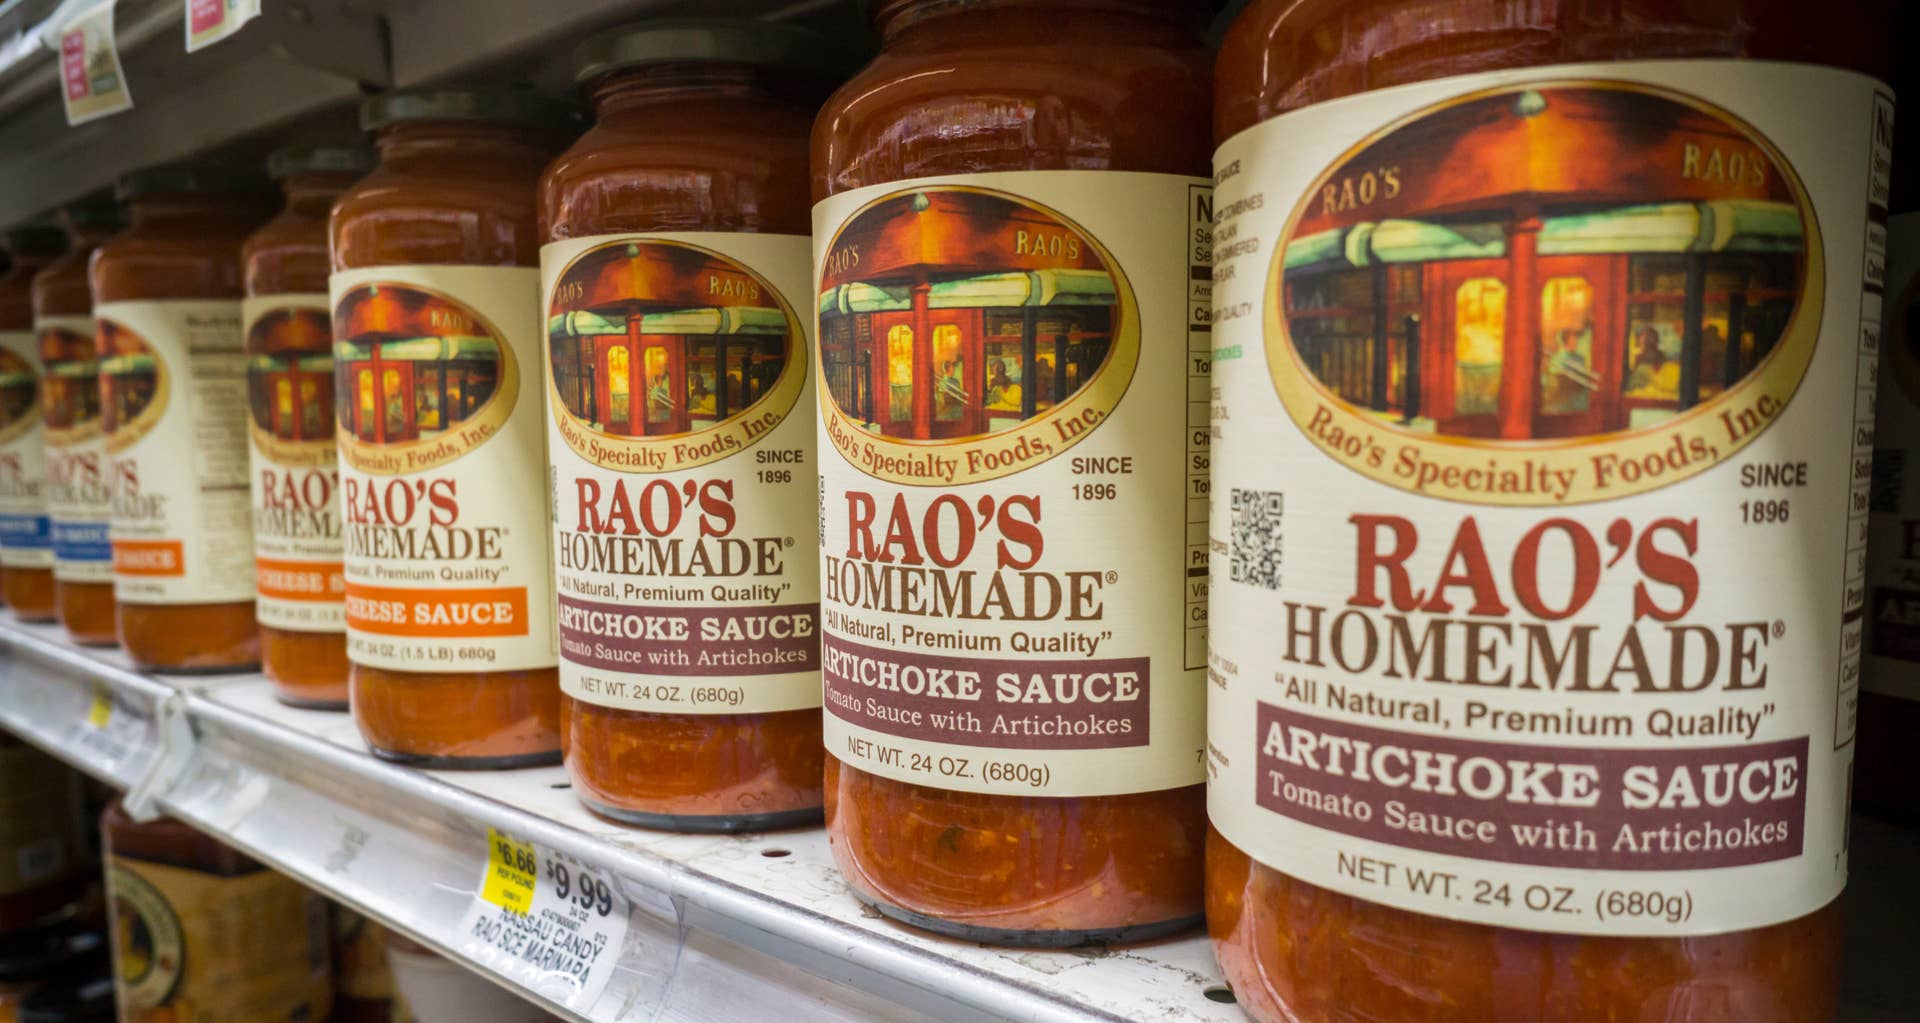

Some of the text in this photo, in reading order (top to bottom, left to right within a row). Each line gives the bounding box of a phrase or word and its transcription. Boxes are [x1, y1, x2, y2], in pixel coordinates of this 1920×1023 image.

[1682, 142, 1766, 188] RAO'S
[1322, 165, 1400, 217] RAO'S
[1015, 229, 1080, 260] RAO'S
[709, 275, 760, 300] RAO'S
[588, 441, 667, 470] Specialty
[674, 433, 742, 464] Foods,
[741, 410, 782, 439] Inc.
[756, 450, 804, 463] SINCE
[828, 405, 1107, 481] Rao's Specialty Foods, Inc.
[1306, 391, 1784, 498] Rao's Specialty Foods, Inc.
[757, 470, 791, 483] 1896
[1071, 456, 1134, 475] SINCE
[1740, 462, 1809, 489] SINCE
[345, 477, 460, 527] RAO'S
[575, 477, 736, 537] RAO'S
[1072, 484, 1117, 501] 1896
[1739, 501, 1791, 523] 1896
[845, 490, 1045, 570] RAO'S
[376, 566, 435, 581] Premium
[1347, 512, 1702, 623] RAO'S
[414, 602, 514, 625] SAUCE
[573, 582, 619, 601] Natural,
[624, 583, 704, 601] Premium
[559, 603, 813, 642] ARTICHOKE SAUCE
[840, 616, 896, 647] Natural,
[902, 624, 1002, 653] Premium
[459, 647, 497, 661] 680g
[595, 643, 642, 664] Sauce
[648, 649, 690, 666] with
[697, 648, 808, 667] Artichokes
[823, 642, 1141, 704] ARTICHOKE SAUCE
[580, 675, 745, 705] NET WT. 24 OZ. (680g)
[825, 680, 1134, 737] Tomato Sauce with Artichokes
[1326, 690, 1452, 730] Natural,
[1465, 701, 1633, 738] Premium
[847, 736, 1051, 787] NET WT. 24 OZ. (680g)
[1262, 721, 1800, 810] ARTICHOKE SAUCE
[1268, 769, 1790, 855] Tomato Sauce with Artichokes
[497, 841, 536, 876] $6.66
[546, 859, 613, 917] $9.99
[1336, 850, 1695, 922] NET WT. 24 OZ. (680g)
[474, 915, 592, 989] RAO SCE MARINARA
[501, 903, 603, 964] NASSAU CANDY
